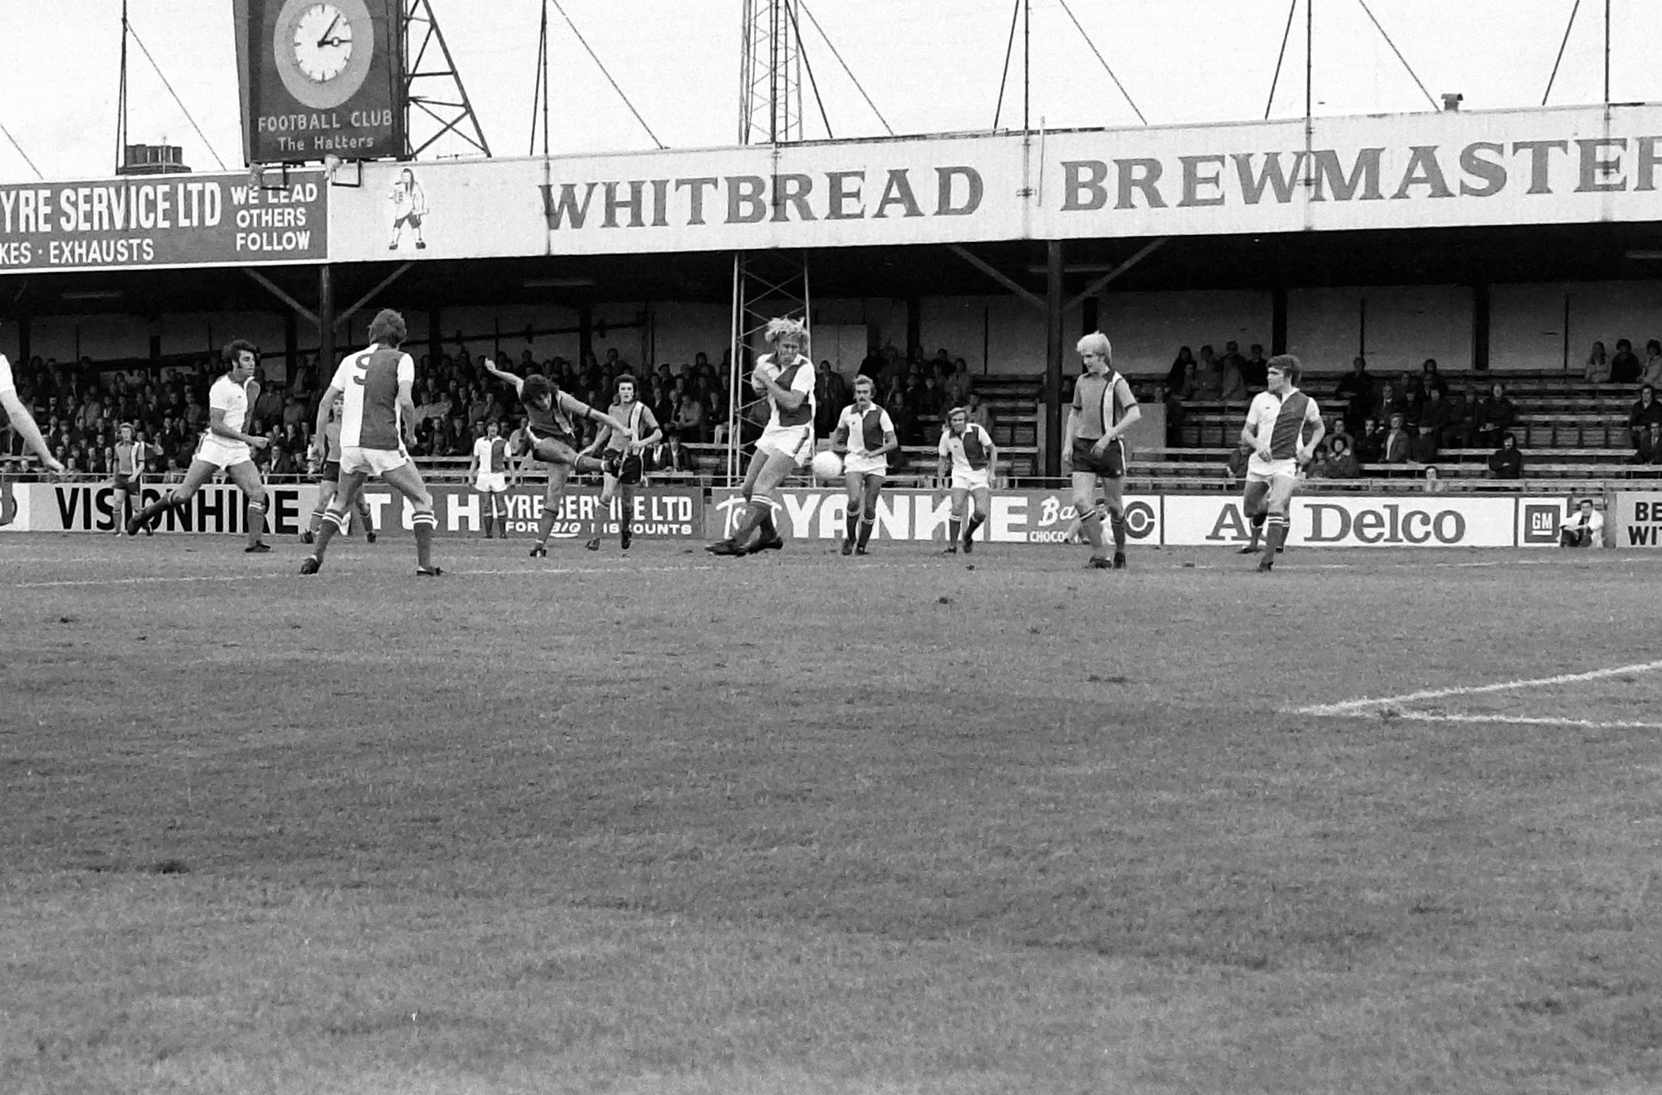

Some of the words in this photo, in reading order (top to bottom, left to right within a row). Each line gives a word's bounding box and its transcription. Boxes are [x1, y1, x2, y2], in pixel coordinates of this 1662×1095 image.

[258, 113, 341, 132] FOOTBALL
[350, 109, 393, 127] CLUB
[277, 136, 305, 151] The
[314, 136, 374, 150] Hatters
[230, 184, 260, 205] WE
[267, 183, 318, 203] LEAD
[538, 165, 985, 231] WHITBREAD
[60, 184, 171, 232] SERVICE
[178, 182, 222, 227] LTD
[236, 206, 307, 228] OTHERS
[49, 238, 154, 264] EXHAUSTS
[236, 230, 310, 251] FOLLOW
[651, 496, 692, 521] LTD
[505, 521, 540, 533] FOR
[589, 522, 692, 534] ISOUNTS
[1303, 503, 1466, 544] Delco
[1532, 512, 1553, 530] GM
[1628, 525, 1662, 546] WI
